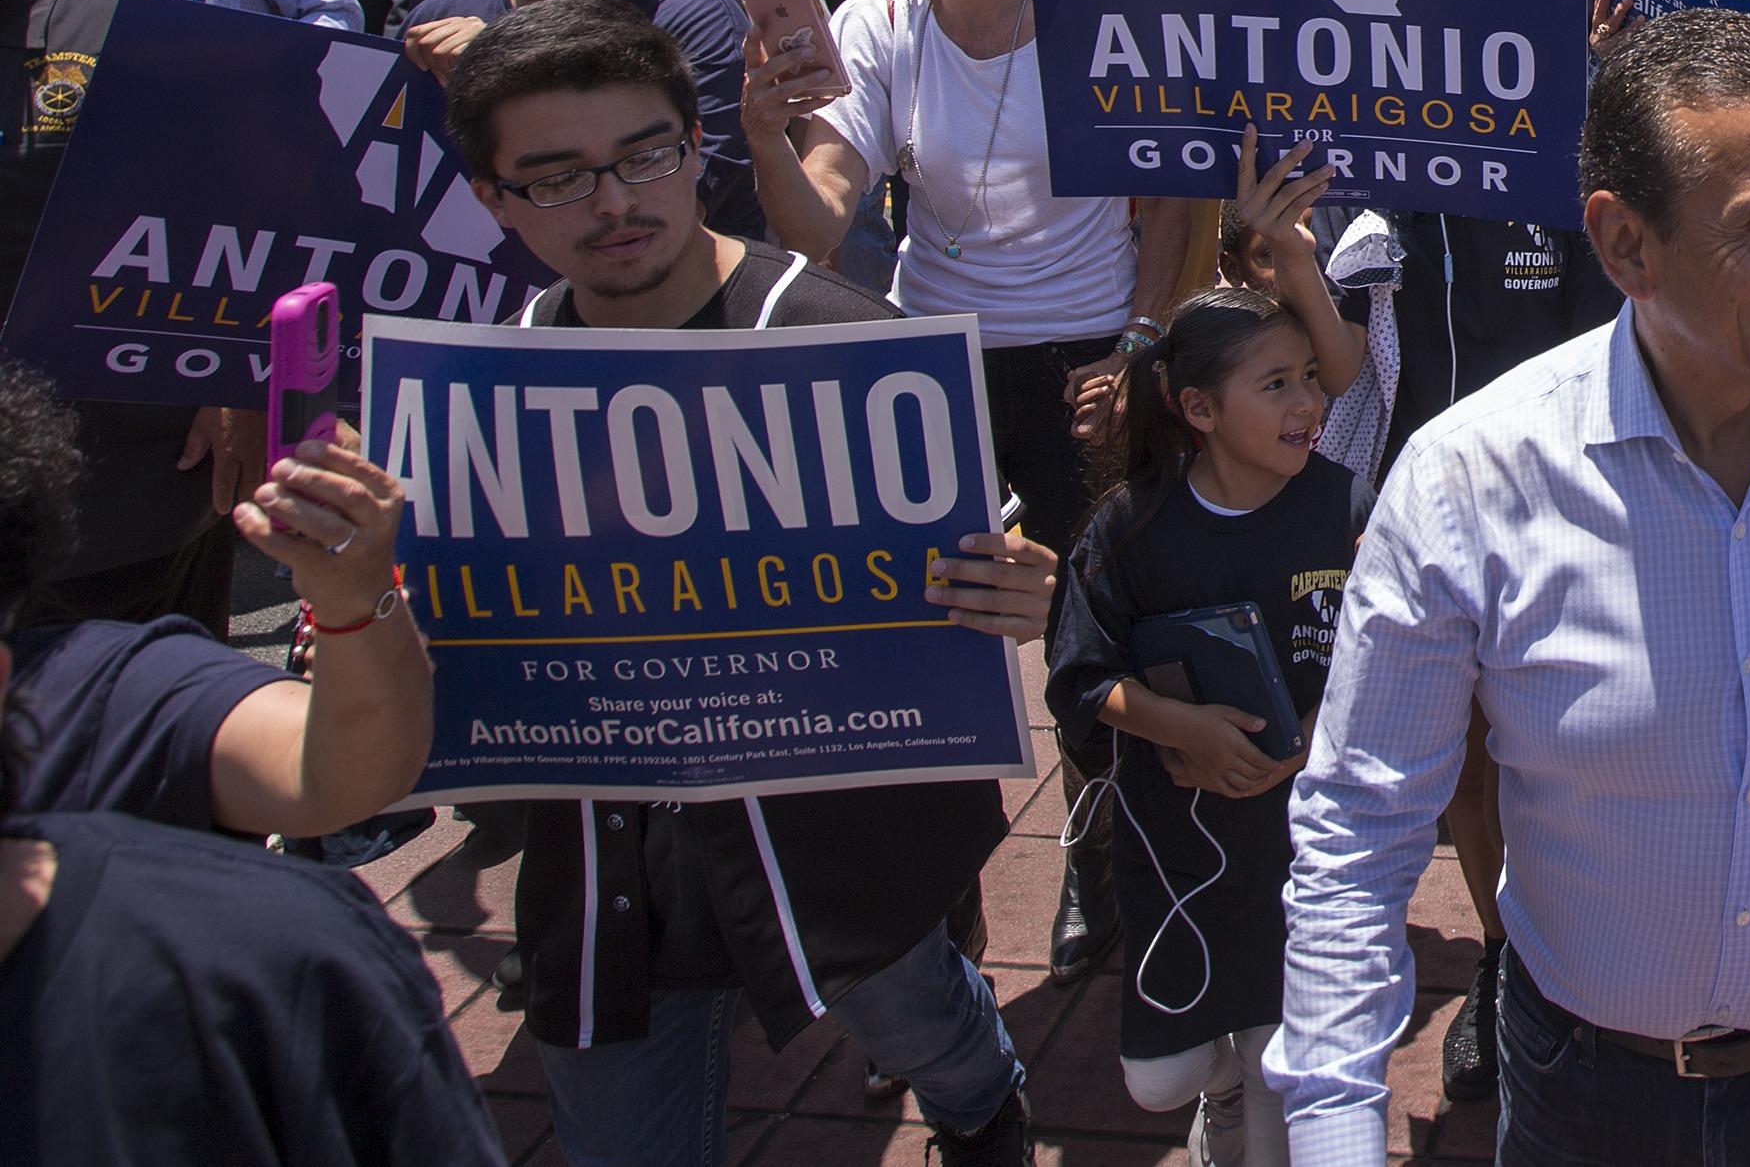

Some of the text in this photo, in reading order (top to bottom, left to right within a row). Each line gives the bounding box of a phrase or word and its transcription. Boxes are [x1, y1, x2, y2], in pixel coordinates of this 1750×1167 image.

[1089, 13, 1535, 101] ANTONIO
[1092, 85, 1537, 138] VILLARAIGOSA
[1293, 129, 1334, 144] FOR
[1504, 277, 1560, 290] GOVERNOR
[386, 370, 958, 539] ANTONIO
[521, 648, 840, 682] FOR GOVERNOR
[588, 689, 784, 715] Share your voice at:
[470, 708, 923, 746] AntonioForCalifornia.com
[444, 759, 457, 768] for
[459, 758, 471, 768] by
[472, 754, 522, 766] Villaraigosa
[523, 754, 536, 764] for
[537, 754, 574, 764] Governor
[575, 754, 602, 764] 2018.
[604, 755, 628, 765] FPPC
[683, 753, 706, 765] 1801
[709, 751, 744, 764] Century
[746, 749, 767, 760] Park
[768, 748, 791, 759] East,
[793, 745, 816, 757] Suite
[818, 743, 845, 754] 1132,
[848, 741, 865, 751] Los
[866, 740, 903, 751] Angeles,
[905, 736, 946, 747] California
[947, 735, 977, 745] 90067
